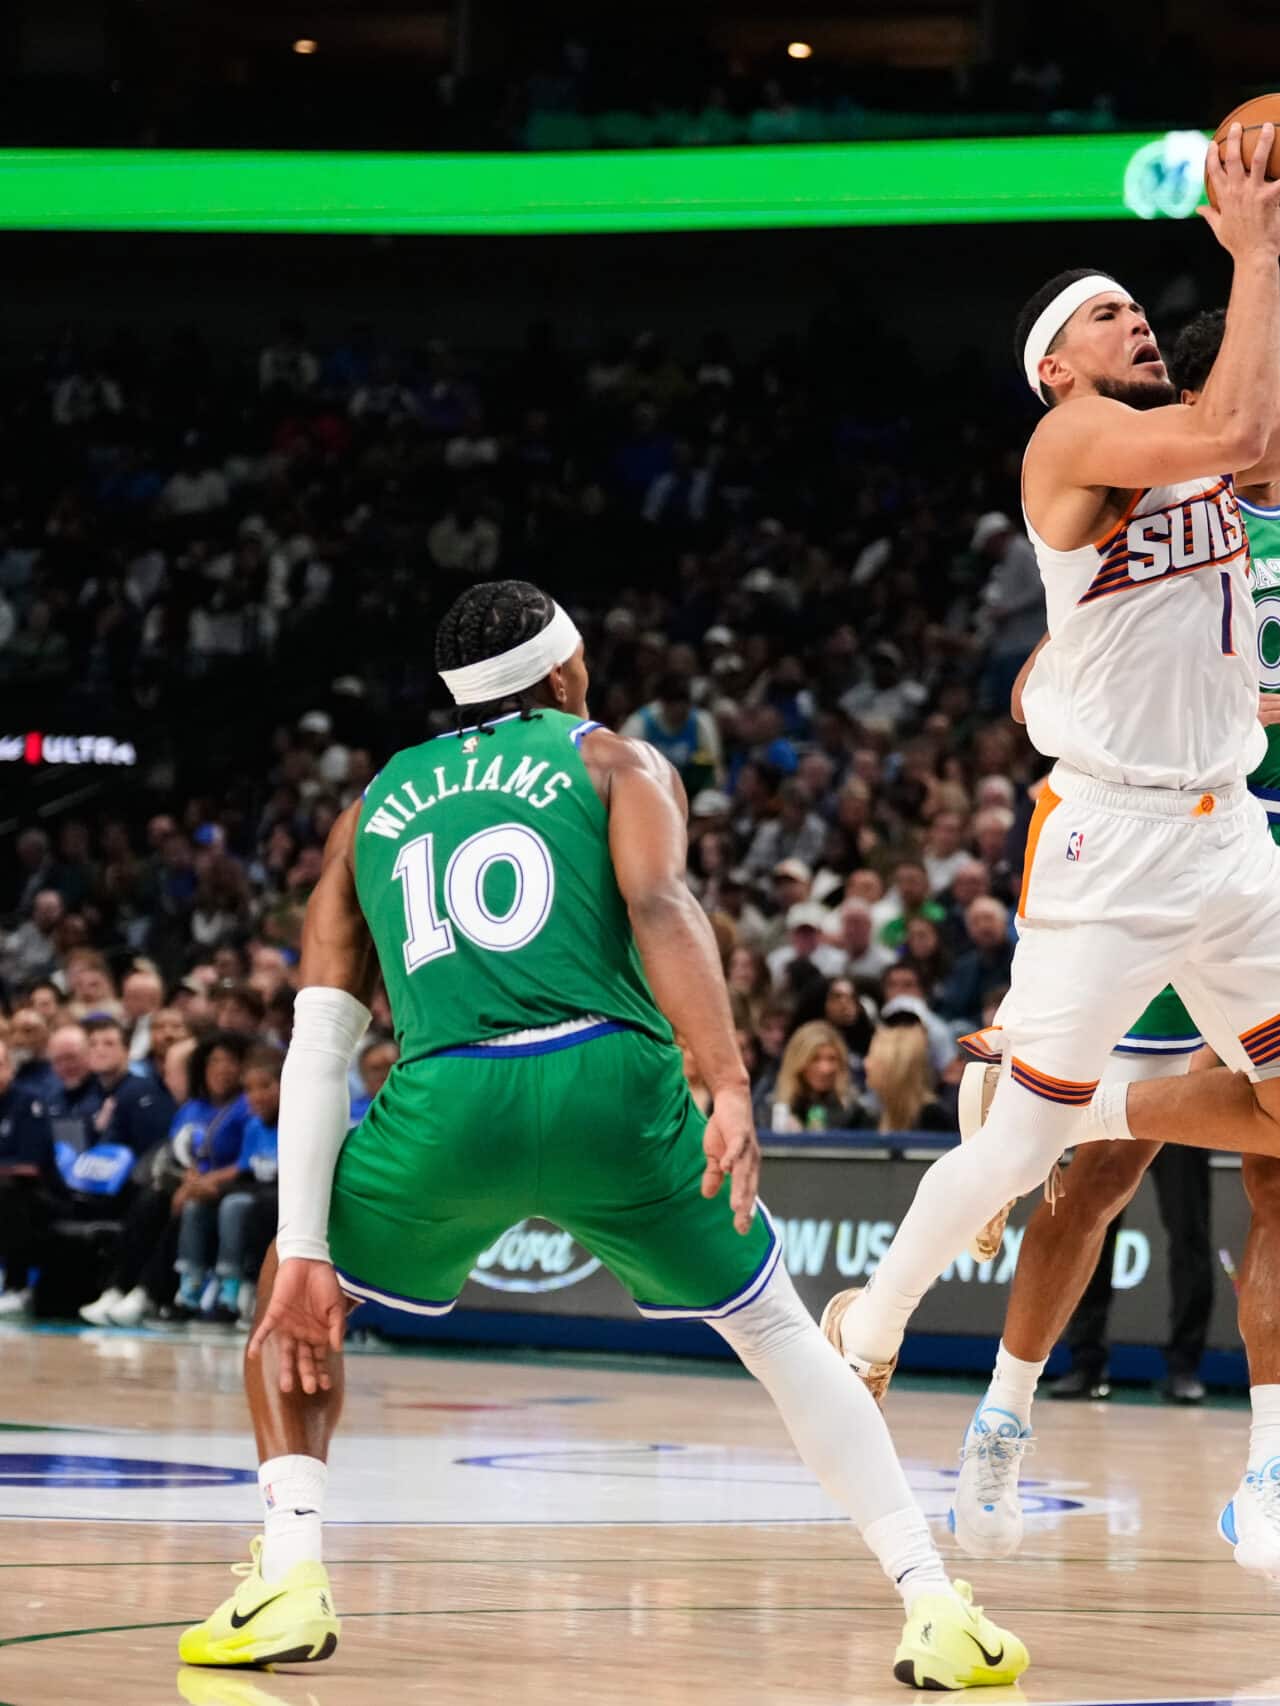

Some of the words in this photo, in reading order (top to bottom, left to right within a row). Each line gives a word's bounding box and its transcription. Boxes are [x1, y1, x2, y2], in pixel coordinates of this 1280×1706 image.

[1219, 571, 1240, 657] 1
[42, 734, 137, 766] ULTRA
[364, 754, 573, 840] WILLIAMS
[391, 822, 556, 976] 10
[836, 1219, 896, 1277] US
